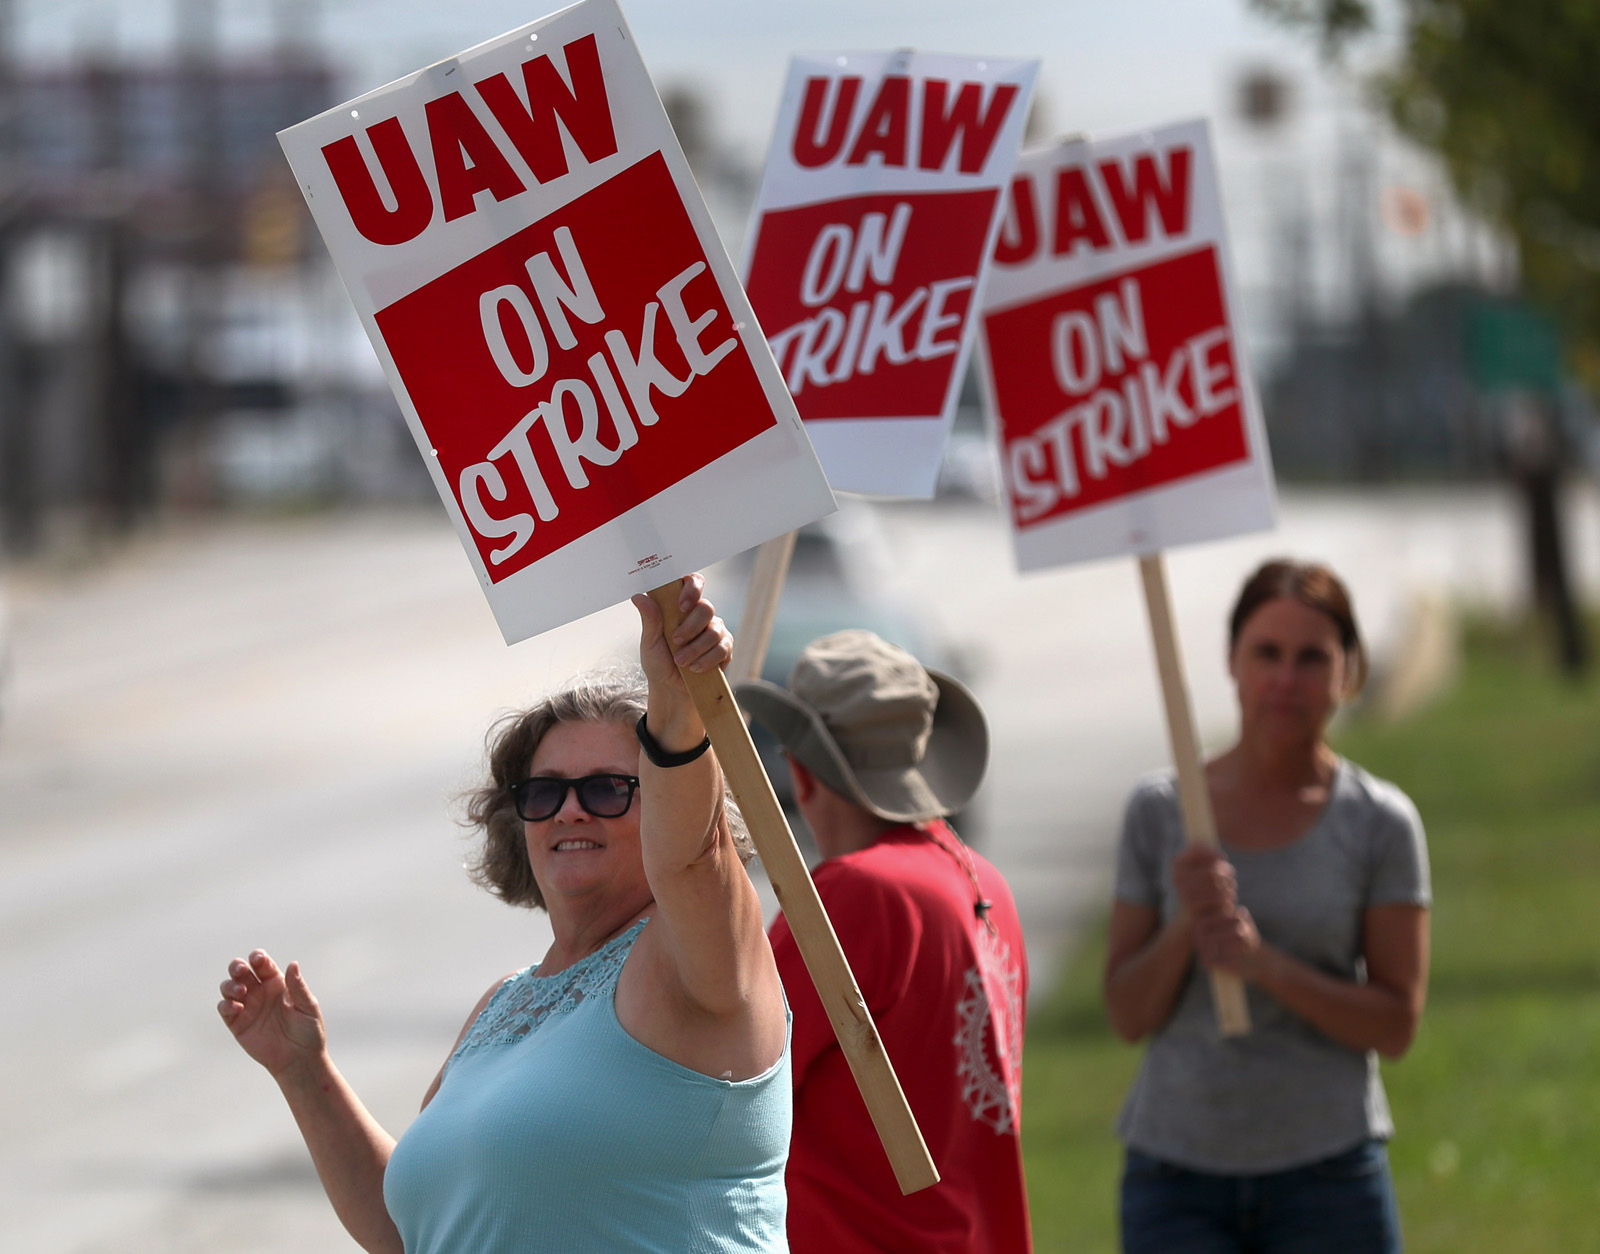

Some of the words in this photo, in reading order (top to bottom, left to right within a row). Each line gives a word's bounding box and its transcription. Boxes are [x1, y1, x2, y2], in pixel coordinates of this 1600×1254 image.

[321, 33, 618, 246] UAW
[792, 76, 1020, 175] UAW
[479, 226, 606, 388] ON
[800, 202, 912, 307] ON
[768, 275, 976, 396] TRIKE
[1051, 277, 1148, 396] ON
[459, 261, 738, 565] STRIKE
[1008, 326, 1240, 521] STRIKE
